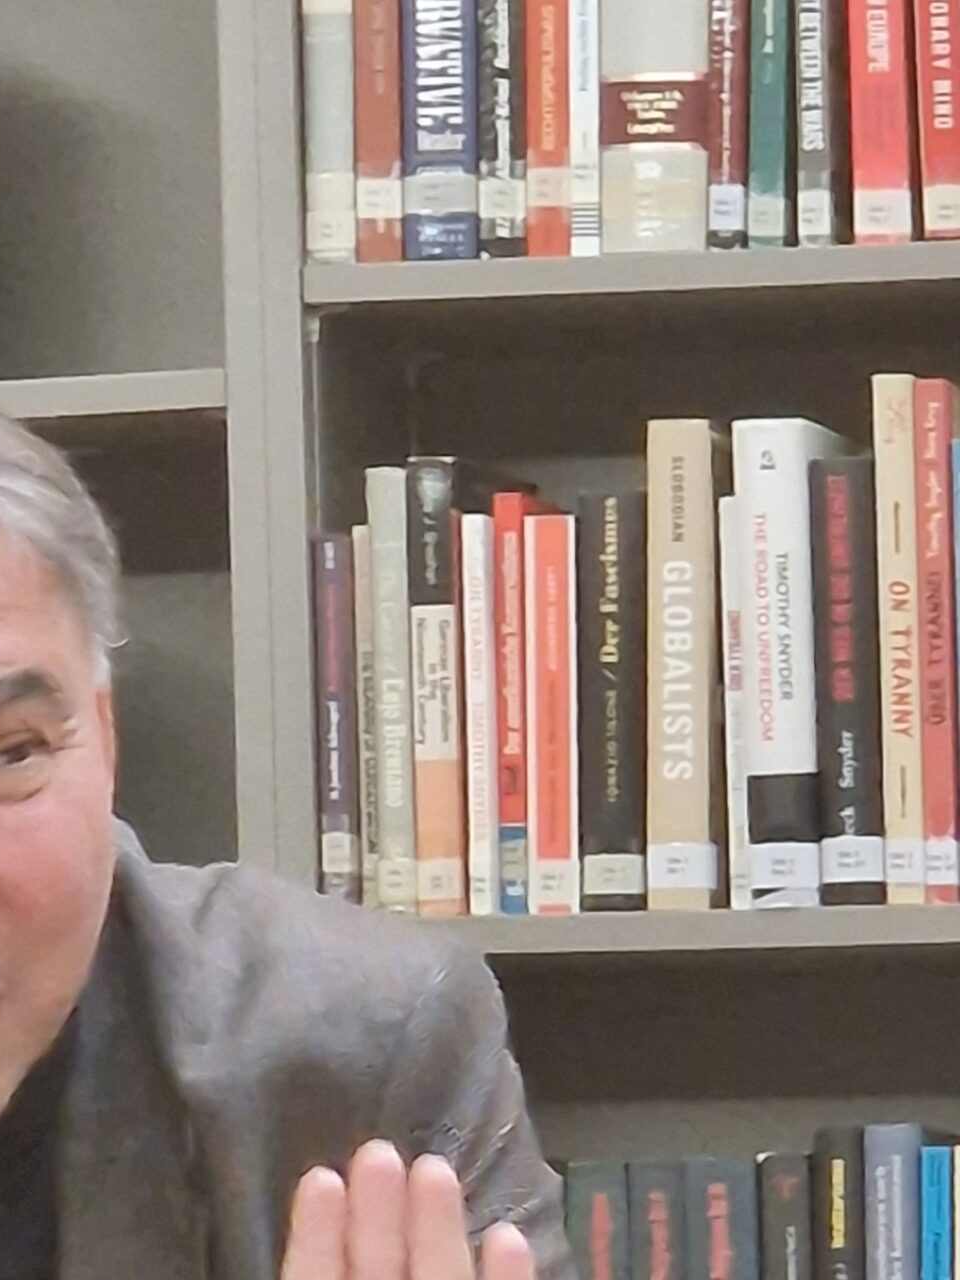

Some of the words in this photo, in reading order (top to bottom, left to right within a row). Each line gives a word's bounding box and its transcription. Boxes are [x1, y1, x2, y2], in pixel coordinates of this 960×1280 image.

[798, 12, 823, 78] BETWEEN
[866, 10, 891, 73] EUROPE
[800, 80, 824, 108] THE
[932, 79, 954, 129] MIND
[802, 109, 826, 152] WARS
[753, 513, 768, 544] THE
[754, 550, 770, 599] ROAD
[775, 553, 792, 629] TIMOTHY
[888, 580, 911, 612] ON
[599, 620, 619, 663] Der
[756, 604, 771, 626] TO
[661, 560, 695, 781] GLOBALISTS
[757, 632, 775, 742] UNFREEDOM
[777, 634, 793, 701] SNYDER
[889, 627, 914, 740] TYRANNY
[839, 730, 856, 788] Snyder
